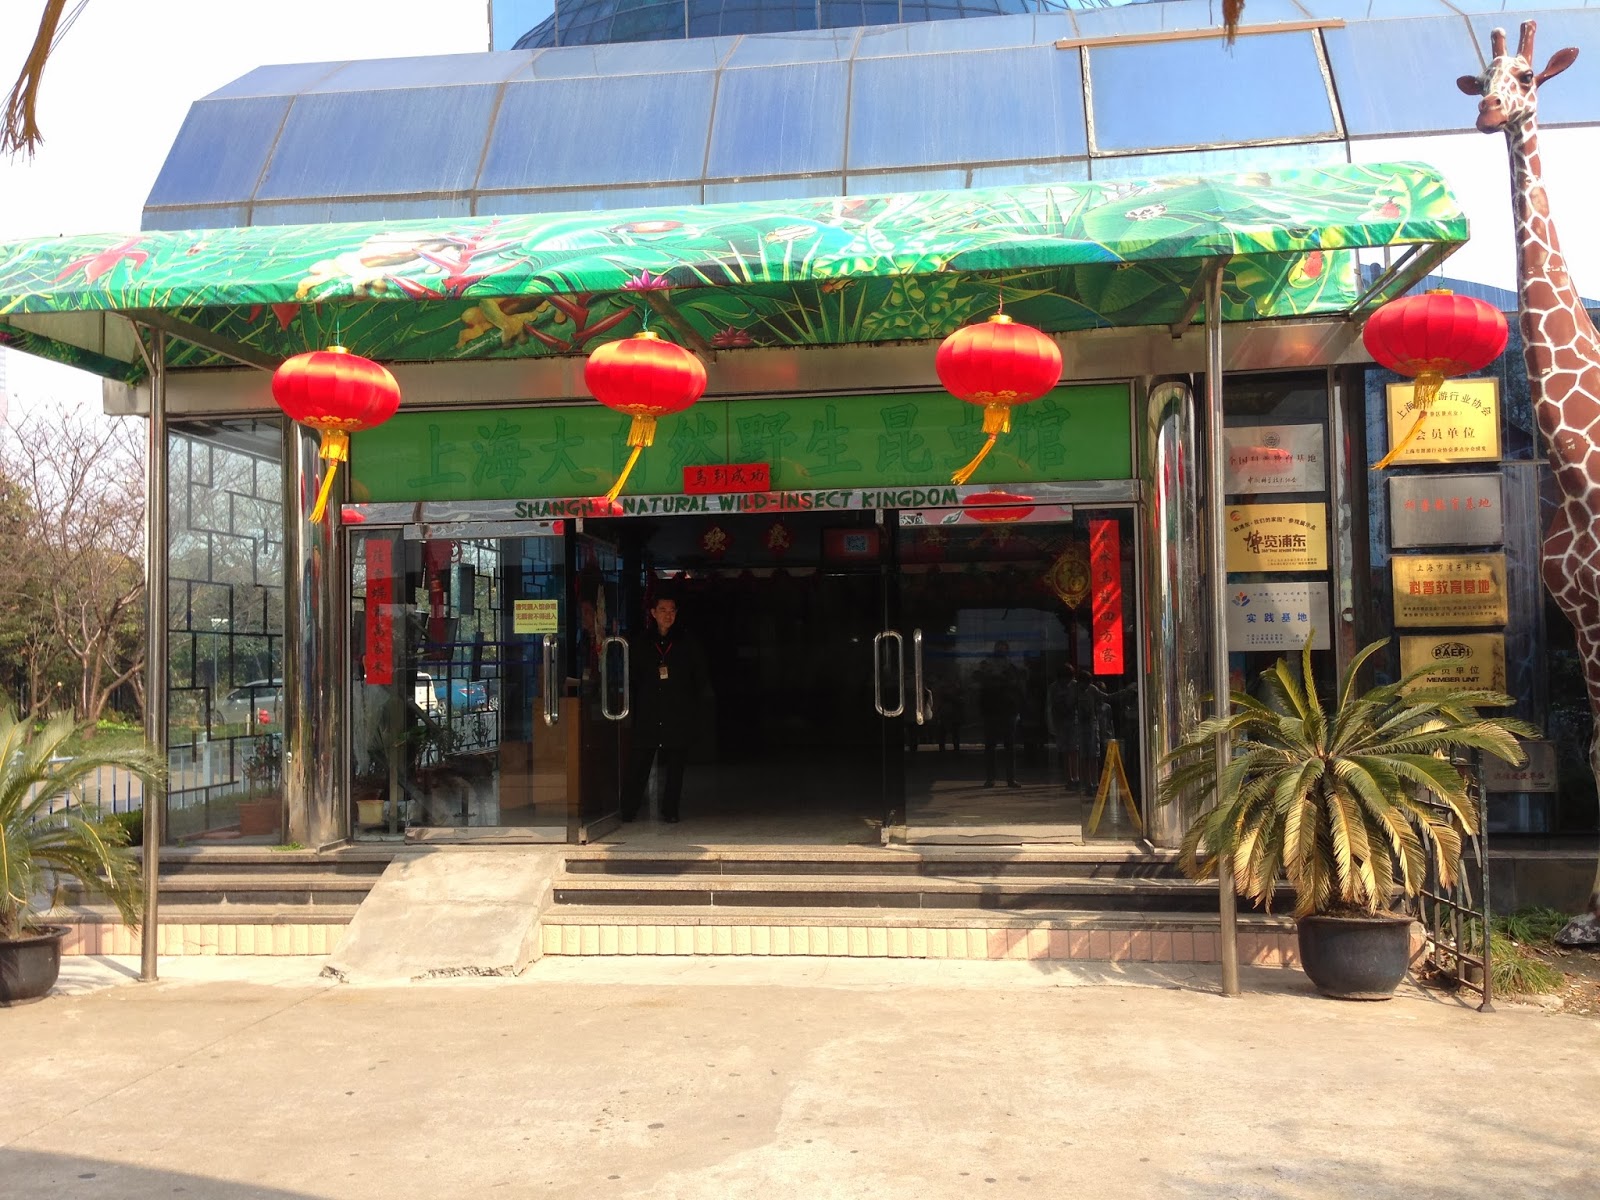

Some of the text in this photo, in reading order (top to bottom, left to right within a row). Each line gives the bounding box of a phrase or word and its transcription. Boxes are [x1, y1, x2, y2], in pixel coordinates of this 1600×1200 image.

[1396, 391, 1493, 420] 上海游行业协会
[514, 488, 959, 519] SHANGHI NATURAL WILD-INSECT KINGDOM
[1408, 579, 1490, 596] 科普教育基地
[1245, 612, 1309, 623] 实践基地
